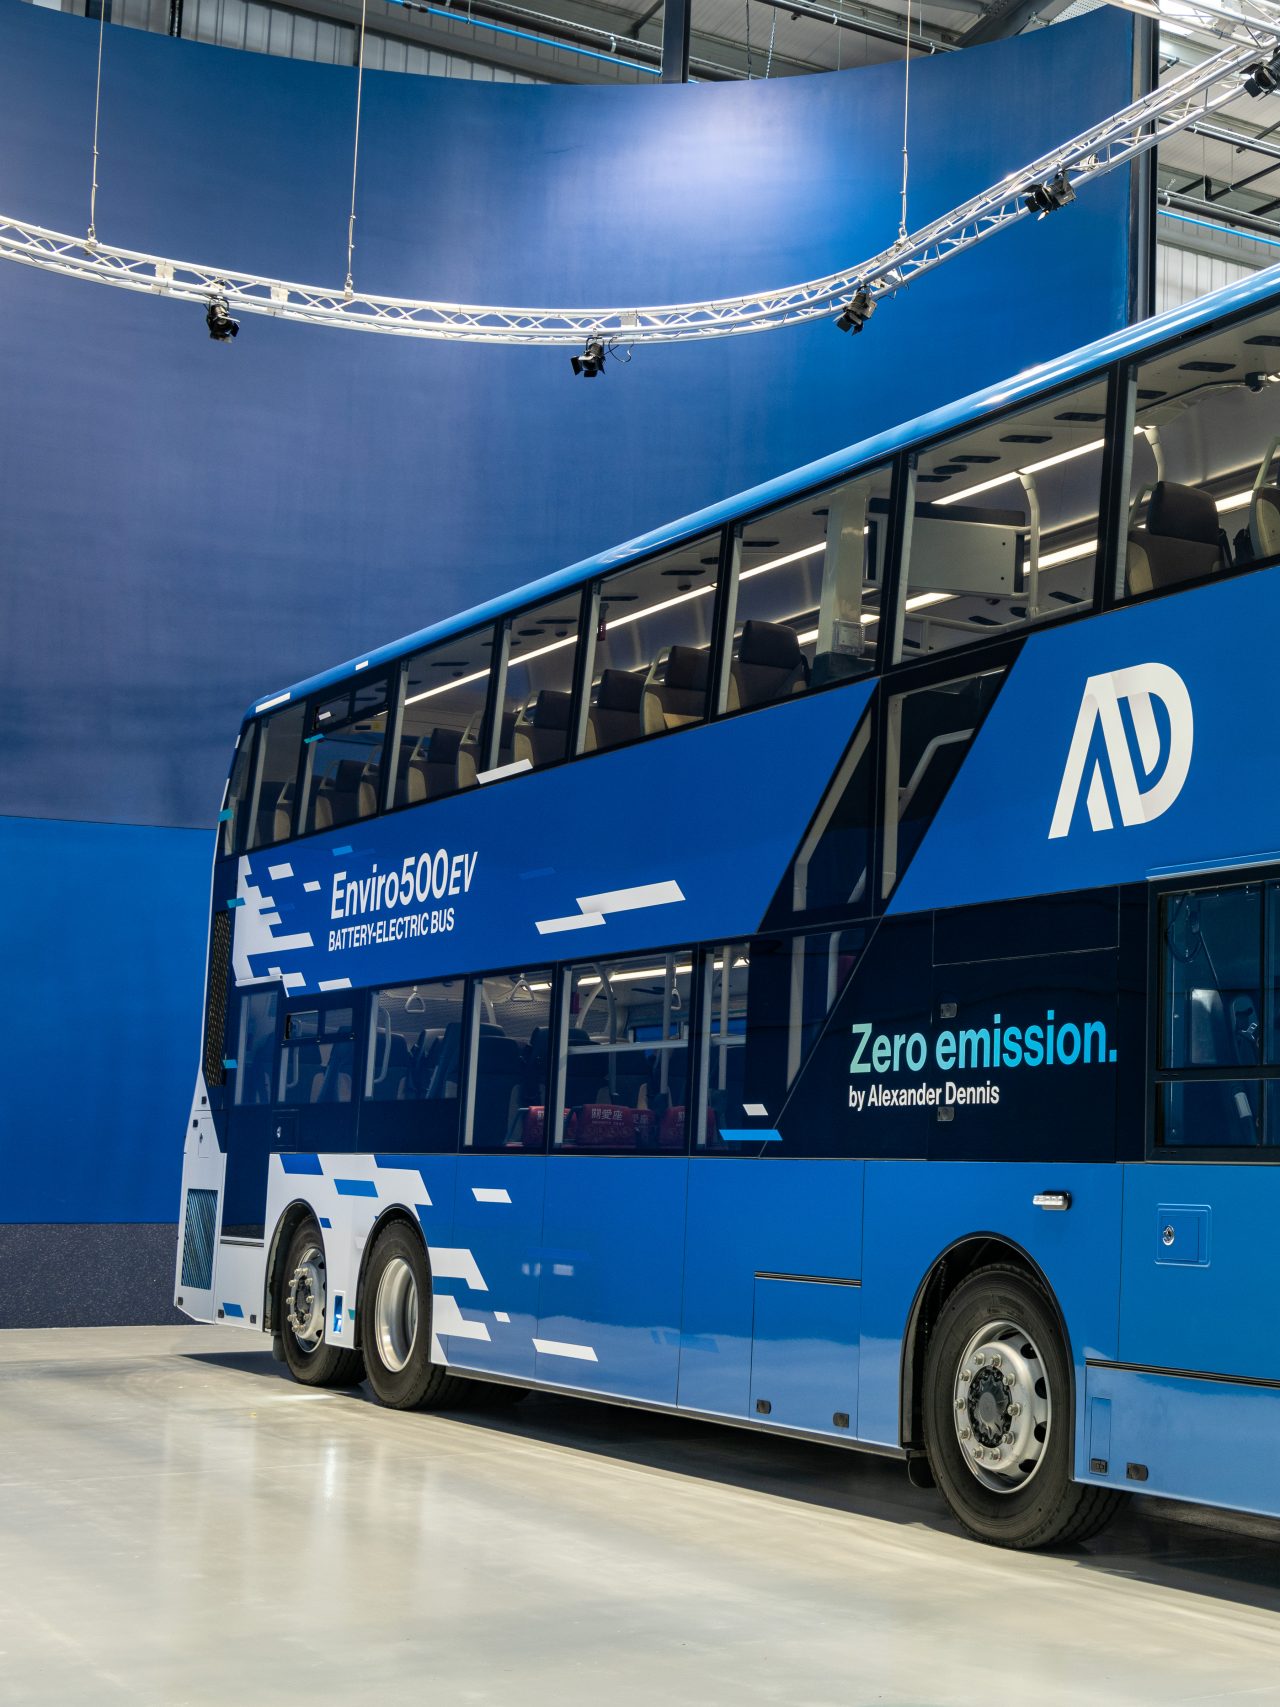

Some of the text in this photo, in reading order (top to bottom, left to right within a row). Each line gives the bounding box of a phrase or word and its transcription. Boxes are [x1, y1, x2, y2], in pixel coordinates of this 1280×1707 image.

[328, 907, 455, 951] BATTERY-ELECTRIC BUS
[850, 1010, 1118, 1074] Zero emission.
[848, 1080, 1000, 1111] by Alexander Dennis
